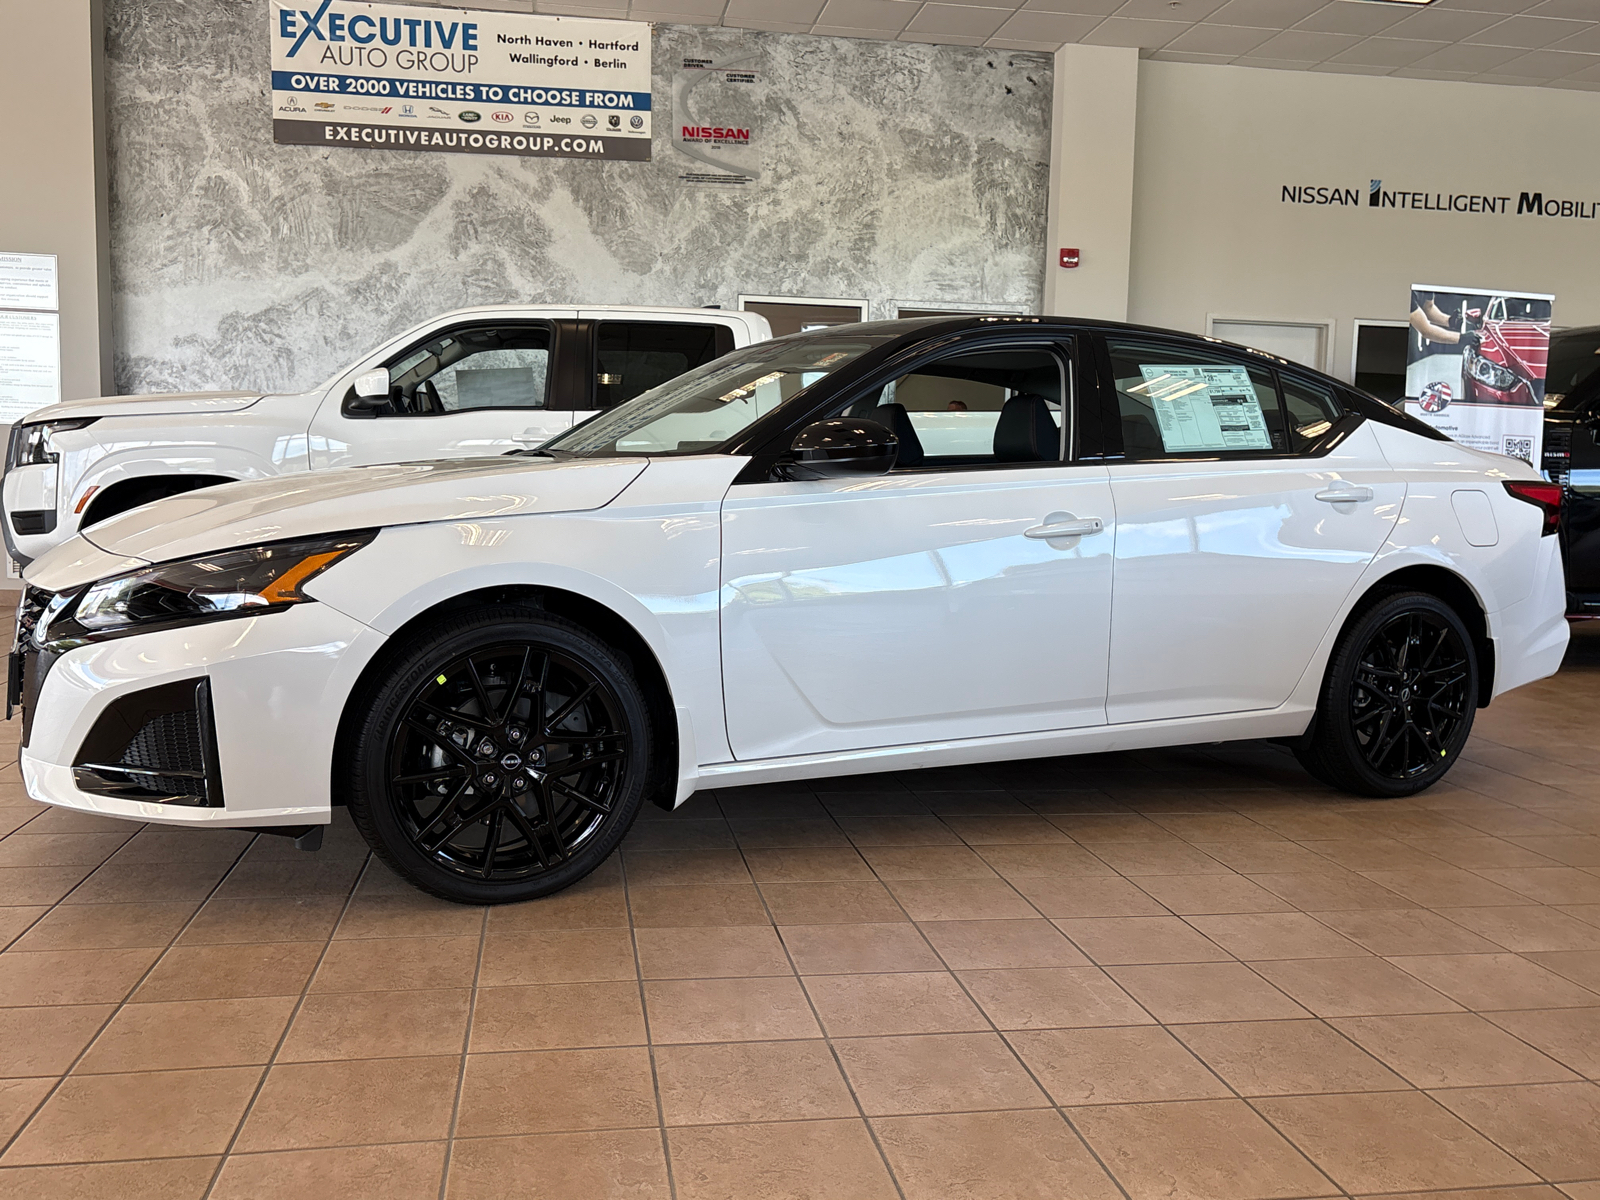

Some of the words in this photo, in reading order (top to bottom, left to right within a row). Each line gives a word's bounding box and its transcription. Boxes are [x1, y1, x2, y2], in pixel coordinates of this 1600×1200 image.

[280, 0, 478, 58] EXECUTIVE
[497, 34, 532, 46] North
[535, 36, 573, 48] Haven
[588, 39, 639, 52] Hartford
[320, 45, 388, 69] AUTO
[396, 50, 479, 74] GROUP
[509, 53, 579, 68] Wallingford
[594, 58, 627, 69] Berlin
[291, 74, 340, 92] OVER
[345, 78, 391, 95] 2000
[395, 81, 475, 100] VEHICLES
[480, 86, 503, 101] TO
[508, 88, 580, 105] CHOOSE
[585, 92, 634, 108] FROM
[550, 115, 572, 125] Jeep
[682, 126, 750, 140] NISSAN
[324, 126, 605, 154] EXECUTIVEAUTOGROUP.COM
[1281, 185, 1359, 207] NISSAN
[1369, 179, 1511, 214] INTELLIGENT
